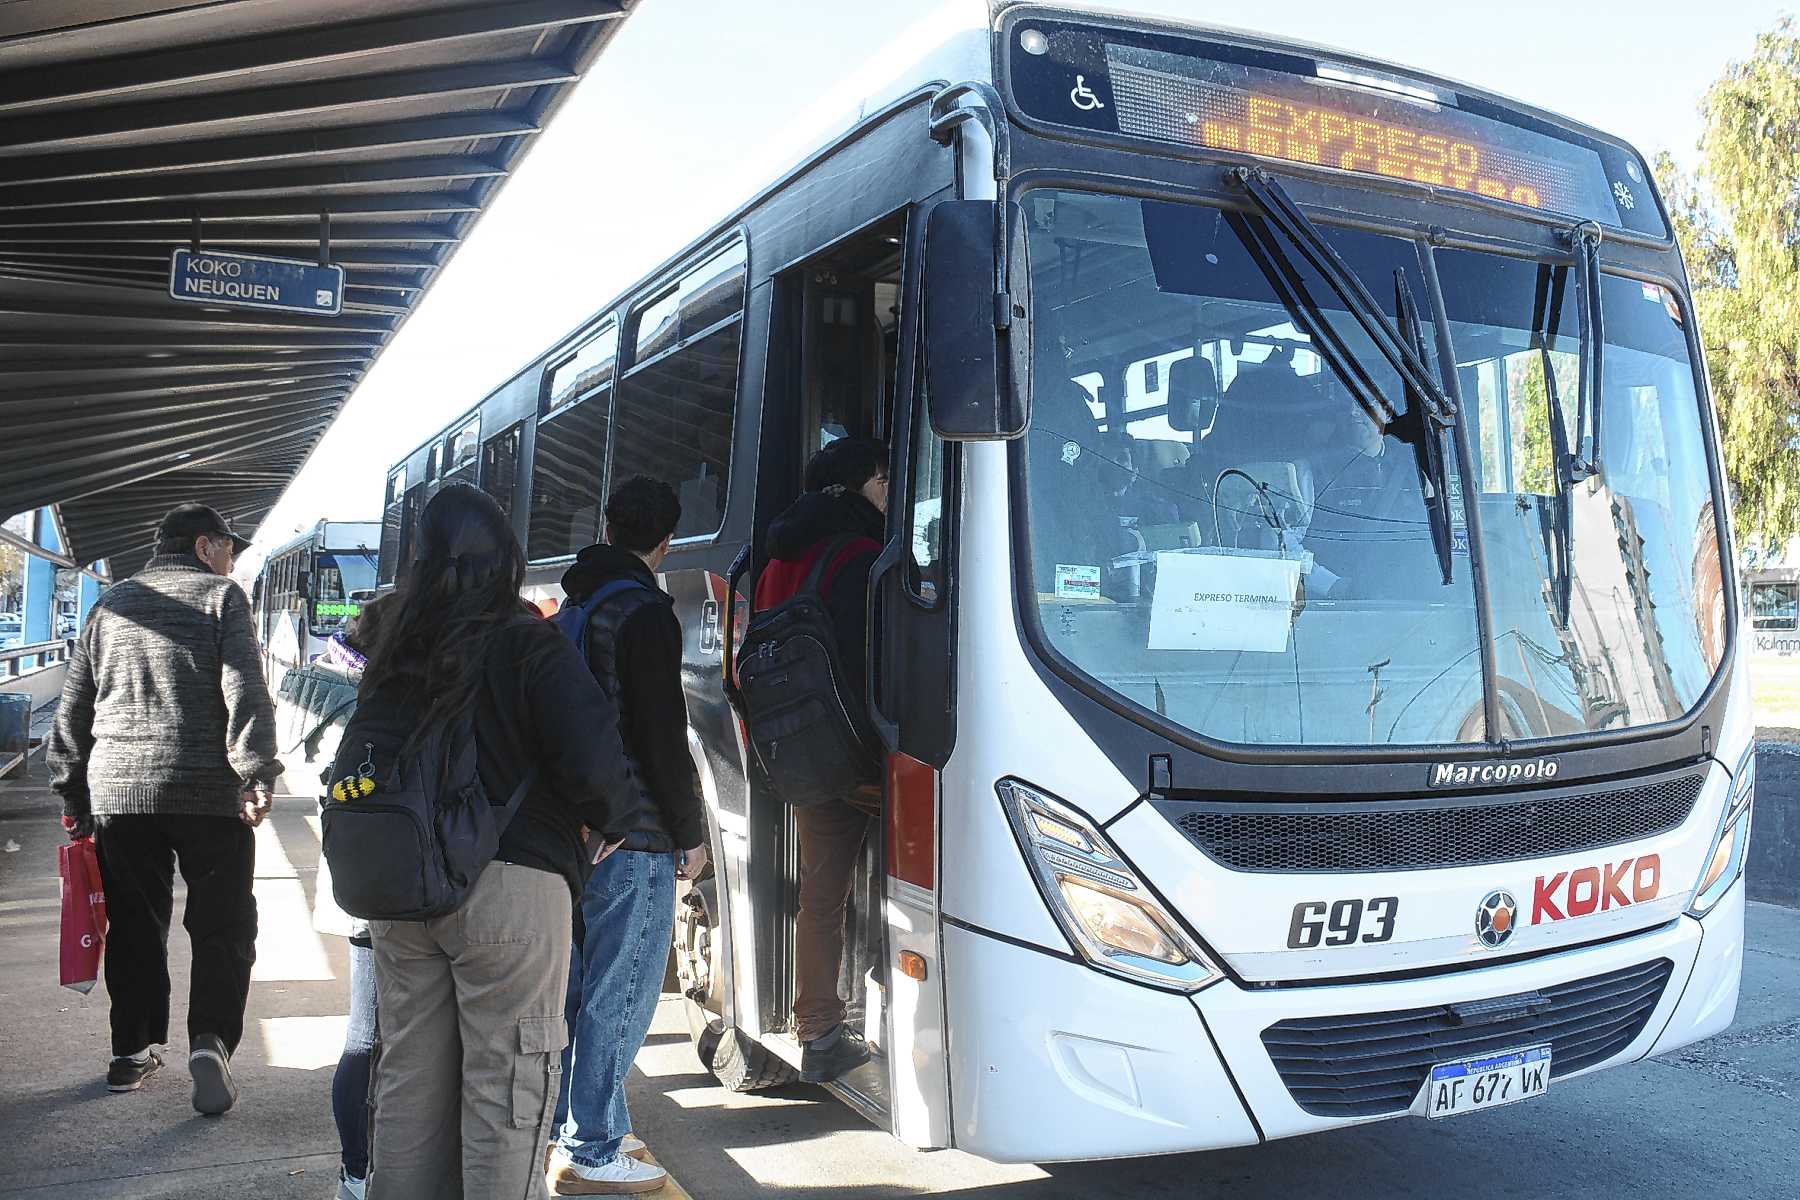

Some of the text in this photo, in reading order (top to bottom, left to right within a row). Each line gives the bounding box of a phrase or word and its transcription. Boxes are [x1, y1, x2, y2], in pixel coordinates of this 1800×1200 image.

[1249, 97, 1479, 174] EXPRESO
[187, 258, 241, 277] KOKO
[185, 277, 280, 301] NEUQUEN
[1193, 592, 1278, 604] EXPRESO TERMINAL
[1435, 759, 1558, 784] Marcopolo
[1531, 853, 1661, 926] KOKO
[1287, 896, 1399, 949] 693
[1436, 1063, 1545, 1111] AF 677 VK
